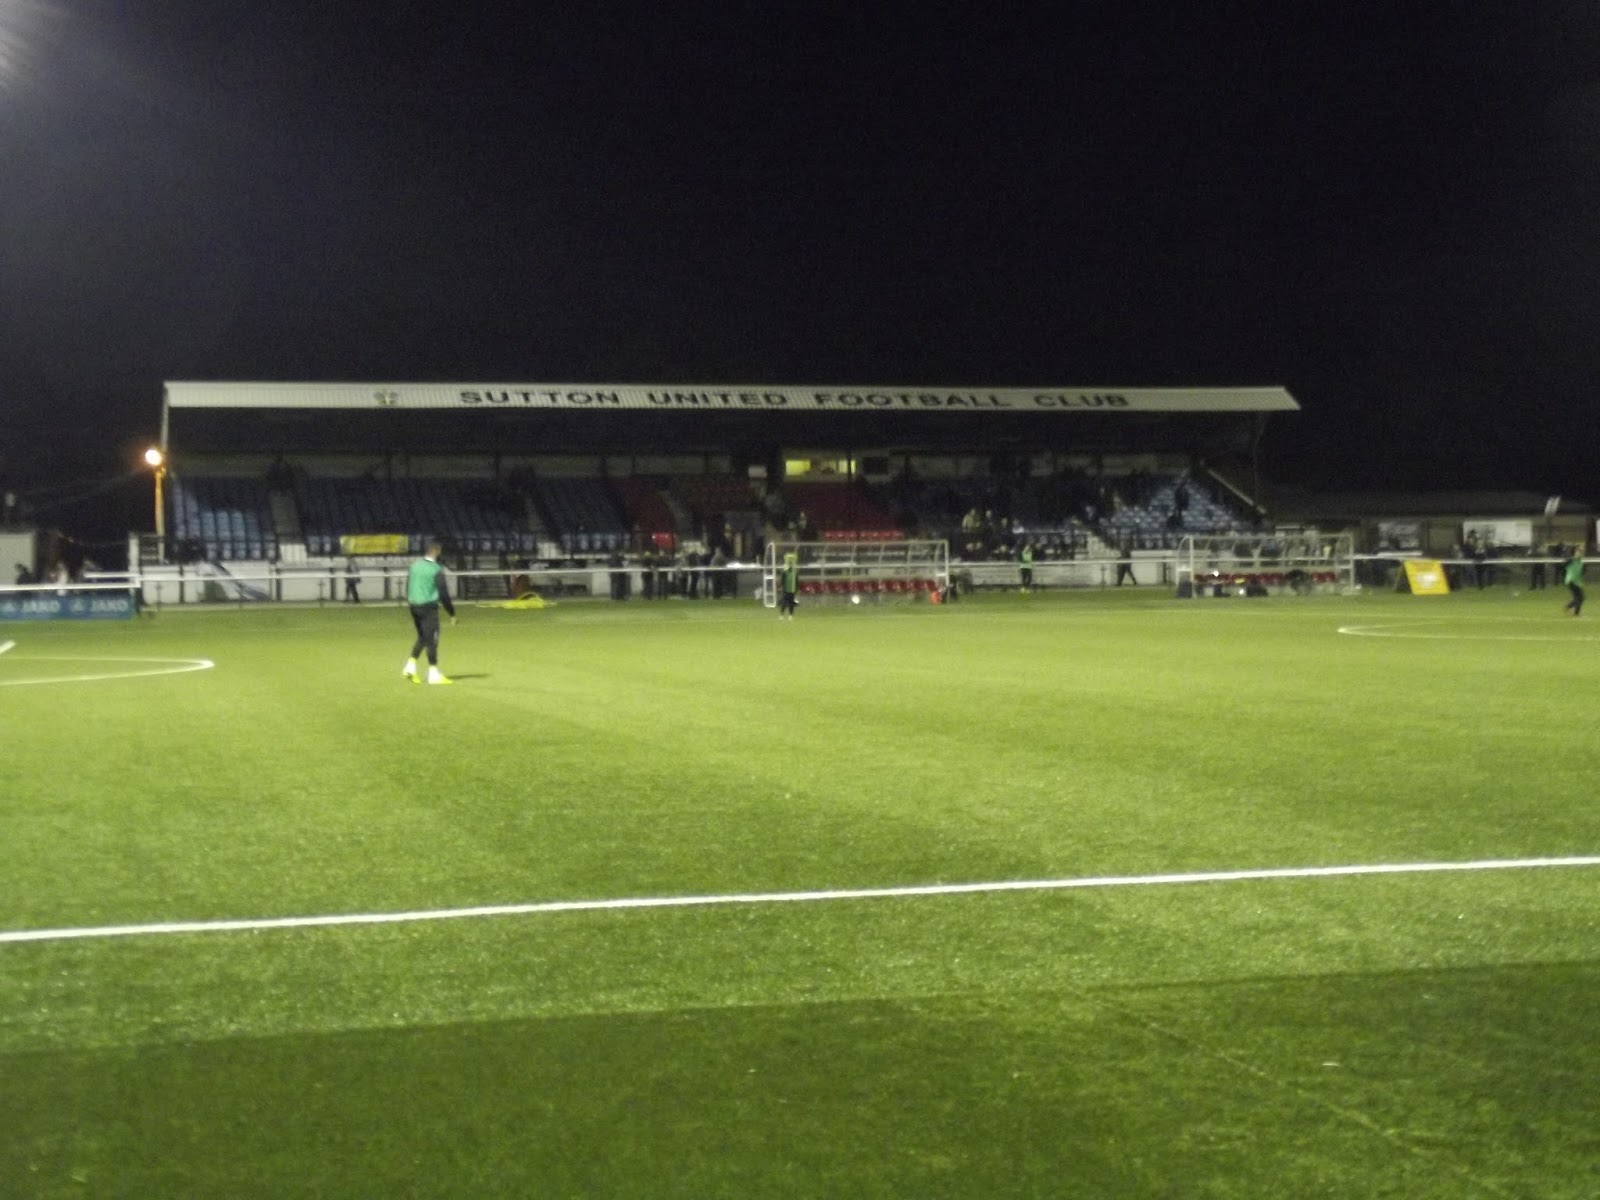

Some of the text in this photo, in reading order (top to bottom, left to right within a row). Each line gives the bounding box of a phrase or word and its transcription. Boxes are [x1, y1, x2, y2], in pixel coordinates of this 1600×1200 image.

[460, 391, 1129, 407] SUTTON UNITED FOOTBALL CLUB
